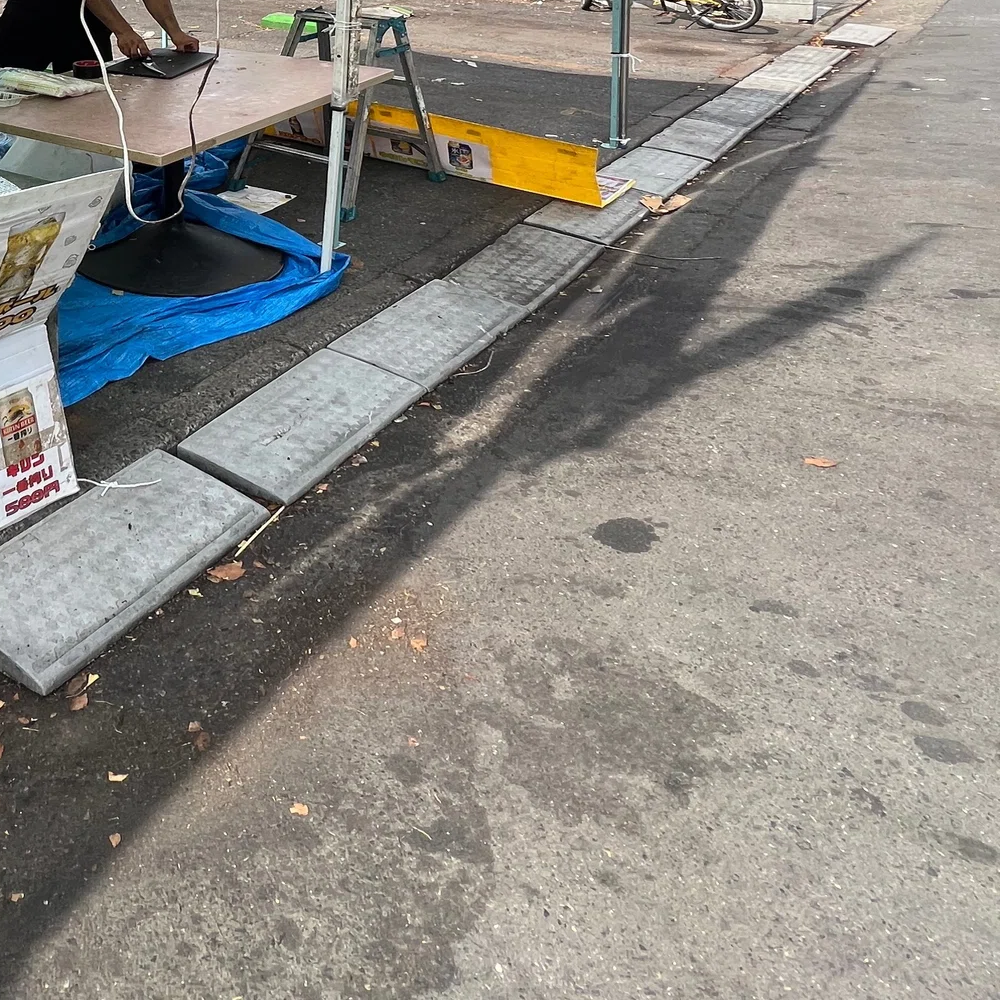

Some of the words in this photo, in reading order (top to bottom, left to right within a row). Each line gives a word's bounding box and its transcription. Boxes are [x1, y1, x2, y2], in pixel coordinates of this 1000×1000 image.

[2, 420, 20, 435] KIRIN
[20, 414, 35, 429] BEER
[6, 452, 45, 478] キリン
[5, 480, 61, 517] 500円
